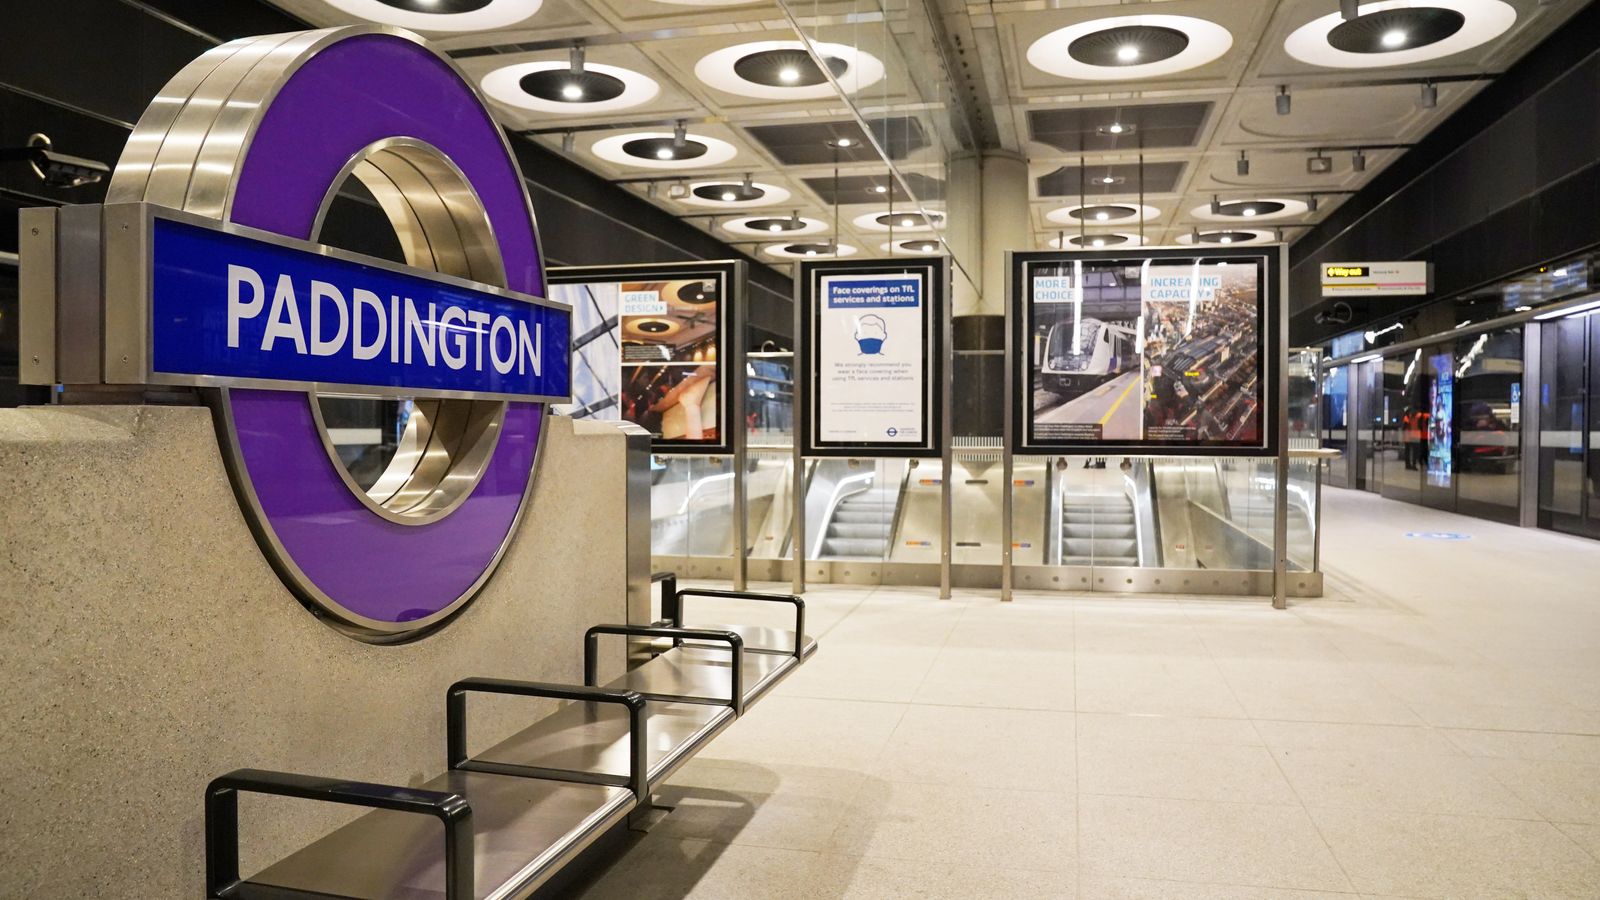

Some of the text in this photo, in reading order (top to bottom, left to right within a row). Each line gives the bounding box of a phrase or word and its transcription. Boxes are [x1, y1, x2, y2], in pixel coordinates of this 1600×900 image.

[1035, 279, 1067, 288] MORE
[1150, 276, 1219, 286] INCREAING
[852, 286, 888, 294] coverings
[902, 284, 914, 292] TfL
[1150, 289, 1204, 298] CAPACIY
[624, 294, 656, 302] GREEN
[833, 294, 914, 304] services and stations
[1035, 290, 1073, 300] CHOICE
[624, 304, 658, 312] DESIGN
[228, 264, 541, 376] PADDINGTON
